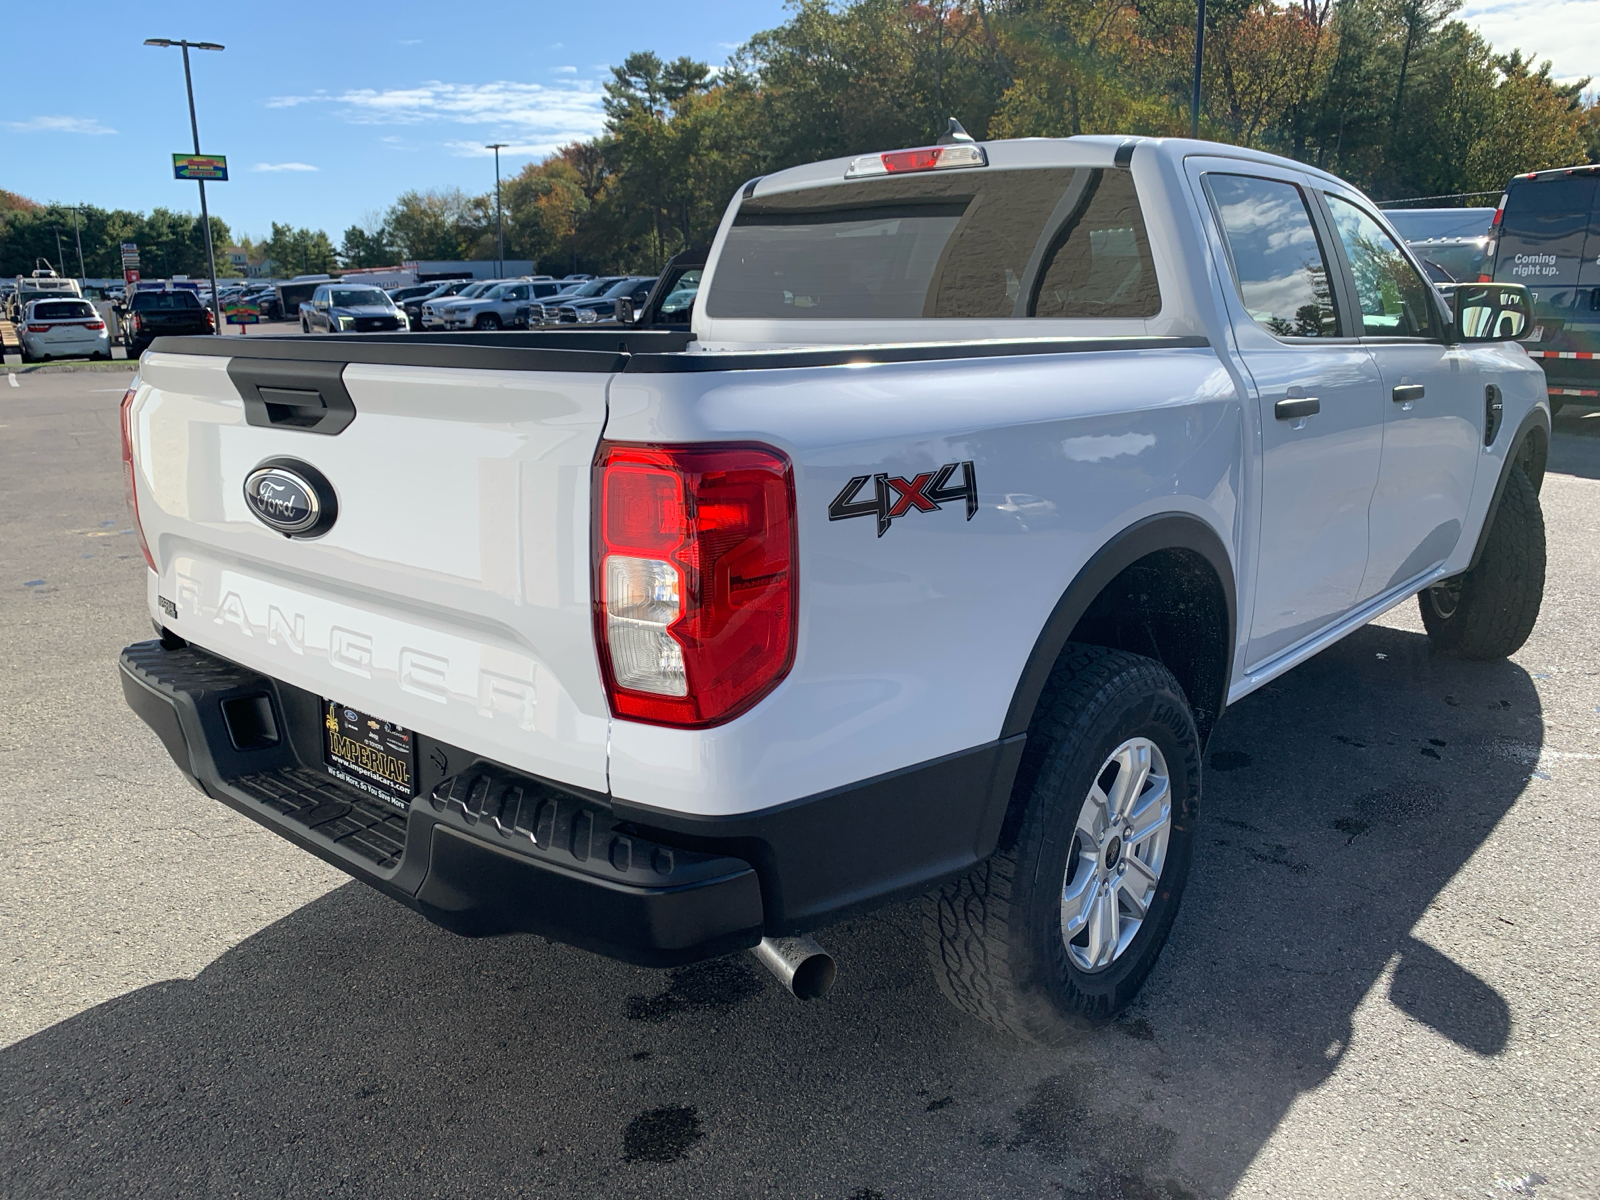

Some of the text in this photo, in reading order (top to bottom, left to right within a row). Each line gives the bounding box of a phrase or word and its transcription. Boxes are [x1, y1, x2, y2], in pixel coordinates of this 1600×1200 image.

[1512, 265, 1559, 277] right up.
[1514, 252, 1557, 265] Coming
[257, 480, 296, 518] Ford
[176, 571, 537, 732] RANGER
[330, 731, 410, 782] IMPERIAL
[331, 754, 410, 795] www.imperialcars.com
[327, 766, 405, 809] We Sell More, So You Save More
